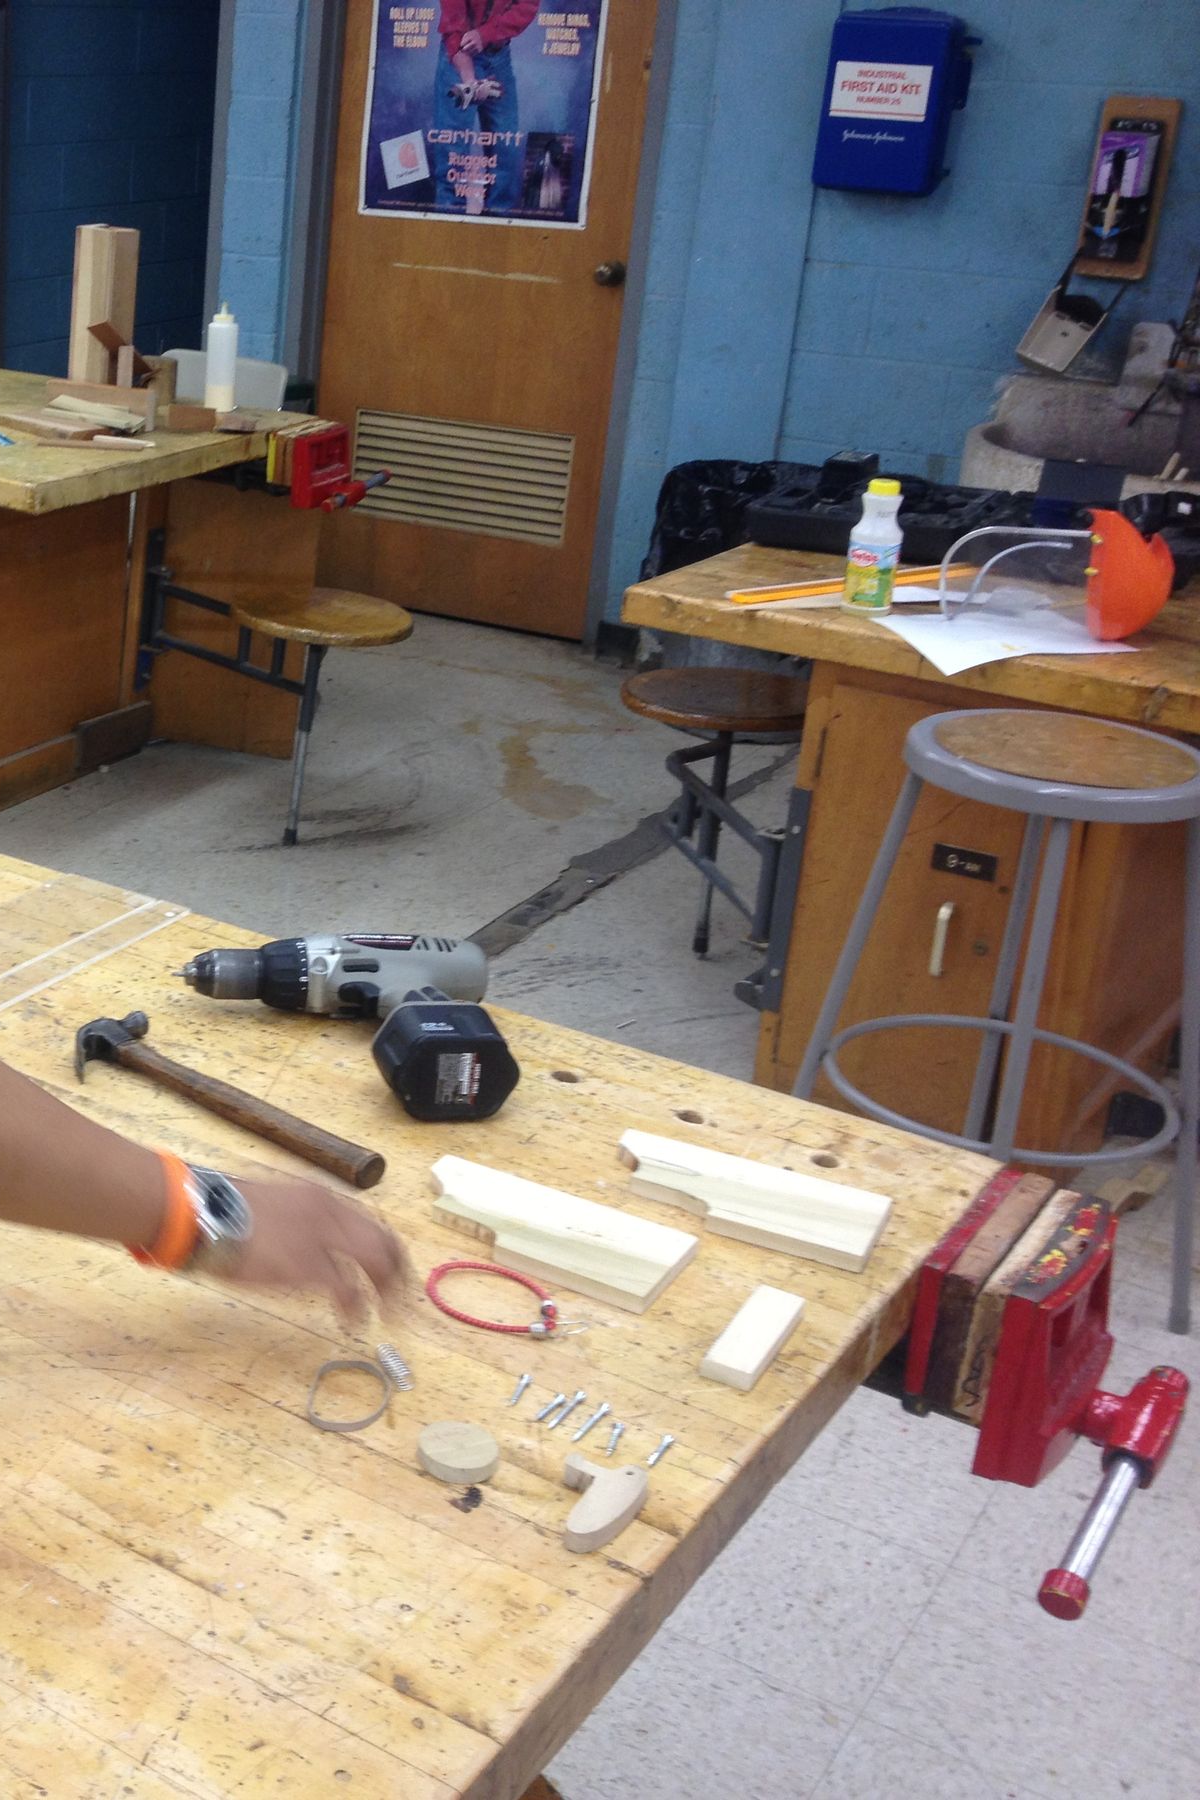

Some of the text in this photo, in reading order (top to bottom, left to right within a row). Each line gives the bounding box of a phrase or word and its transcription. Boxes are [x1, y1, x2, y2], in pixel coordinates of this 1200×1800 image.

[857, 69, 908, 80] INDUSTRIAL
[840, 80, 922, 95] FIRST AID KIT
[856, 96, 890, 105] NUMBER
[427, 128, 523, 146] carhartt
[448, 152, 498, 169] Rugged
[446, 169, 497, 184] Outdoor
[455, 183, 488, 198] Wear
